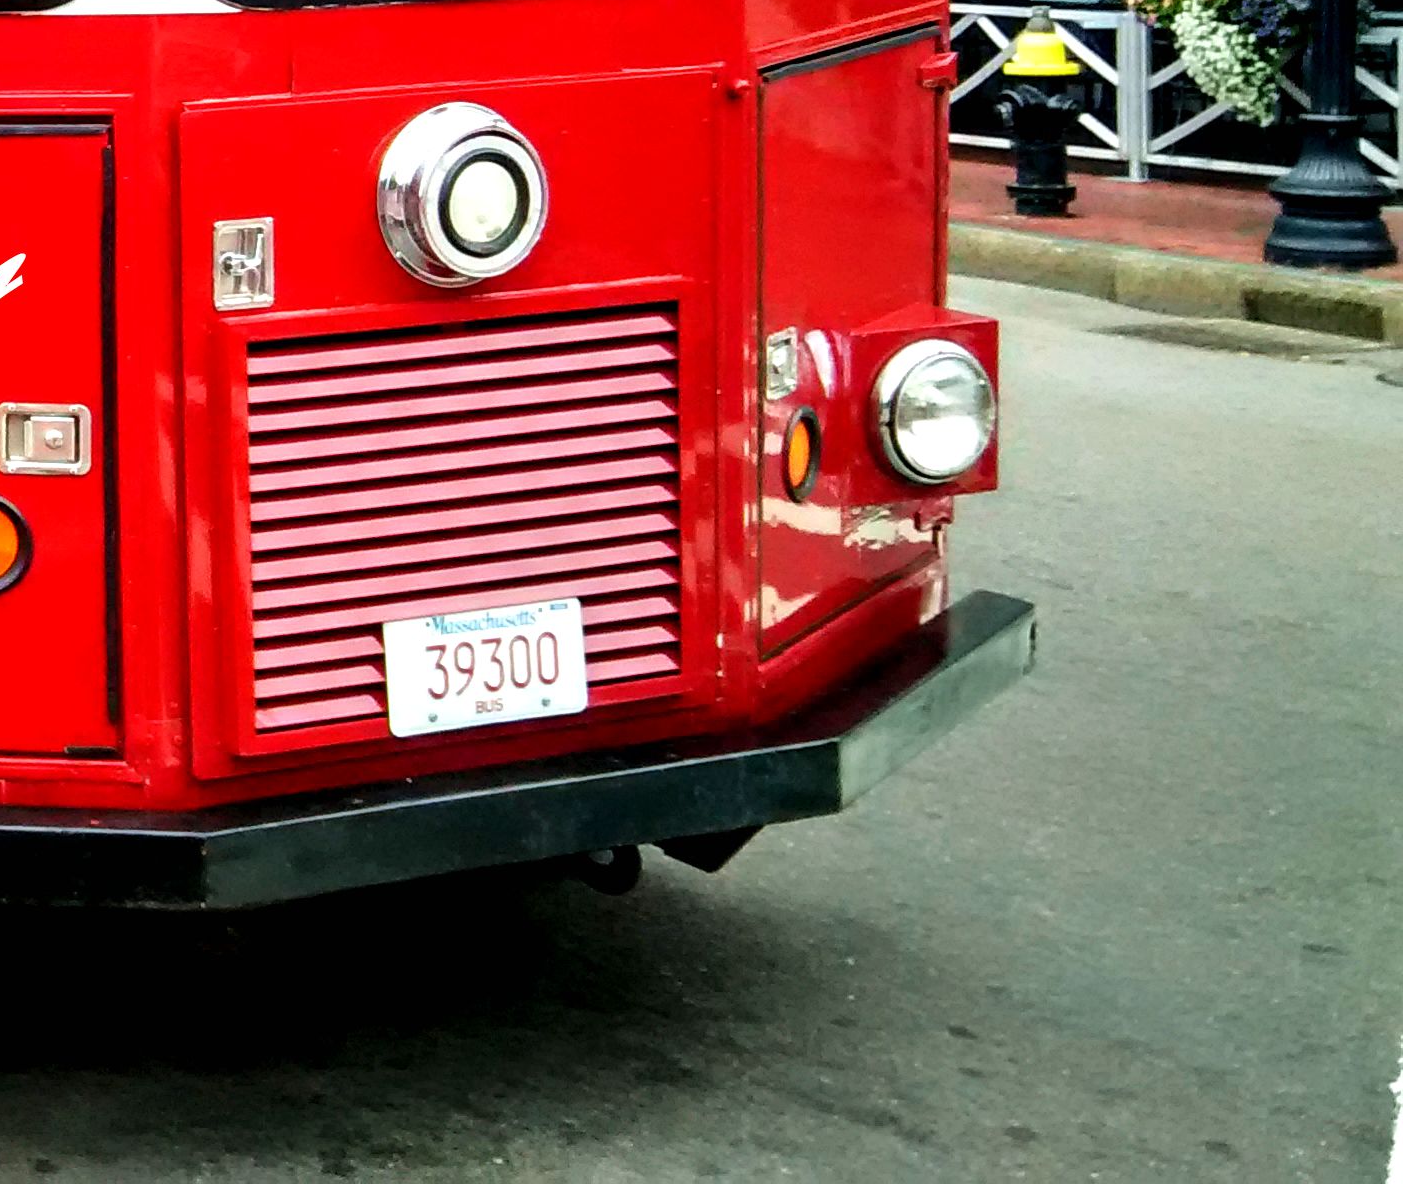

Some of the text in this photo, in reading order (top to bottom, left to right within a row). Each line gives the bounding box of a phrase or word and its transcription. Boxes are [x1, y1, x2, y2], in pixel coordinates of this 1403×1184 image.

[431, 609, 537, 636] Massachusetts
[425, 631, 561, 700] 39300
[475, 699, 504, 714] BUS
